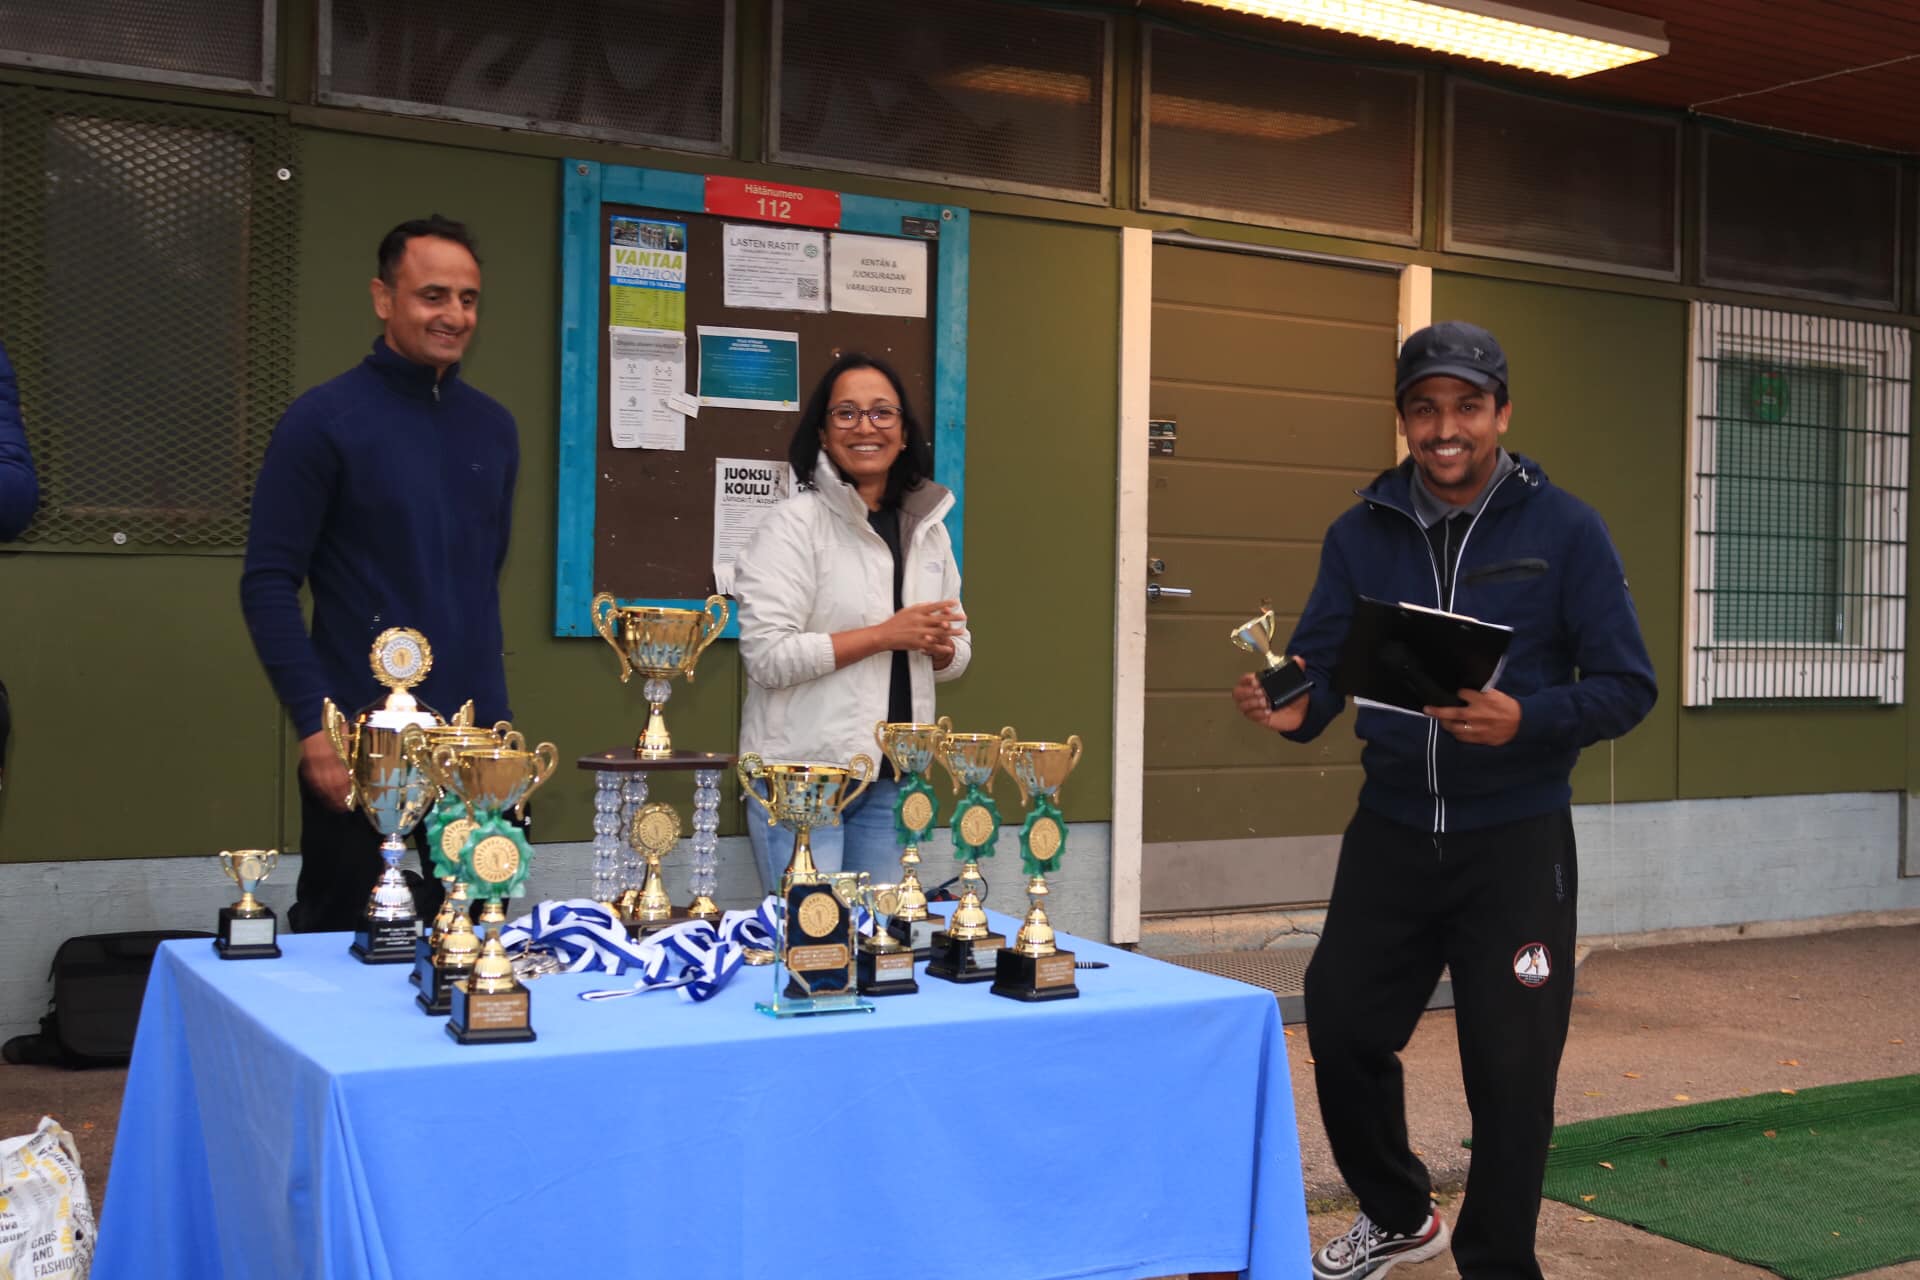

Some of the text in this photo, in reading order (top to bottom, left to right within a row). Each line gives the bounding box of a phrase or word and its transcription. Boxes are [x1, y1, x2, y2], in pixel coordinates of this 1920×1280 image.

[744, 183, 804, 201] Hätänumero
[756, 197, 792, 219] 112
[730, 237, 800, 251] LASTEN RASTIT
[615, 248, 683, 270] VANTAA
[616, 265, 683, 282] TRIATHLON
[852, 270, 906, 281] JUOKSURADAN
[724, 467, 772, 481] JUOKSU
[724, 482, 770, 496] KOULU
[31, 1230, 57, 1249] CARS
[32, 1246, 54, 1263] AND
